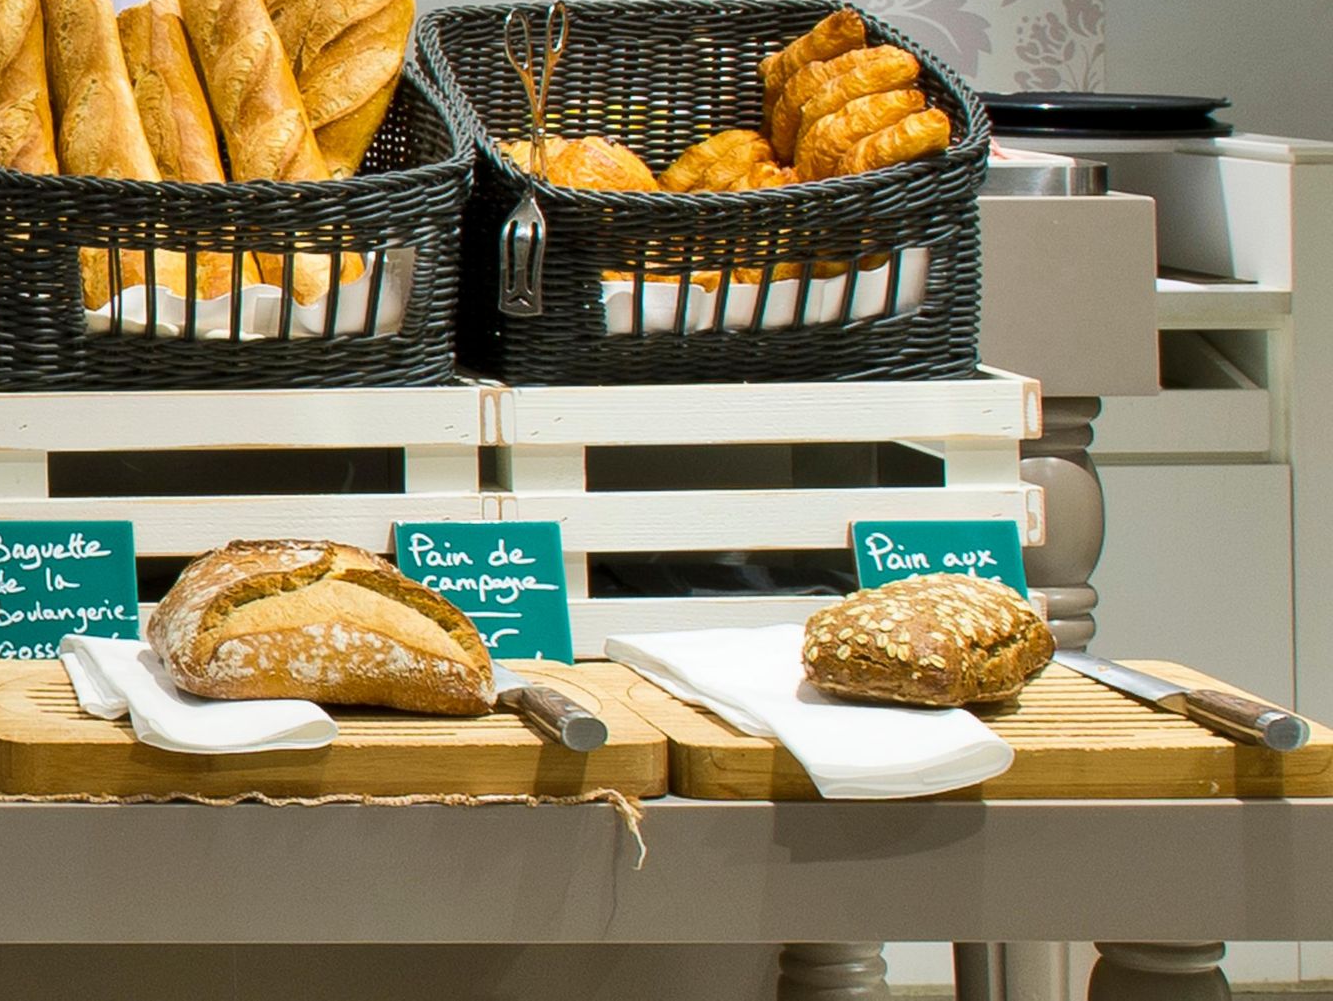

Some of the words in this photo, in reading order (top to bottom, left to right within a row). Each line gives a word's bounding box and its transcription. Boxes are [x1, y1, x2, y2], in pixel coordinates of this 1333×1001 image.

[408, 533, 473, 567] Pain
[488, 539, 536, 567] de
[865, 532, 930, 572] Pain
[943, 549, 997, 568] aux
[45, 567, 81, 592] la
